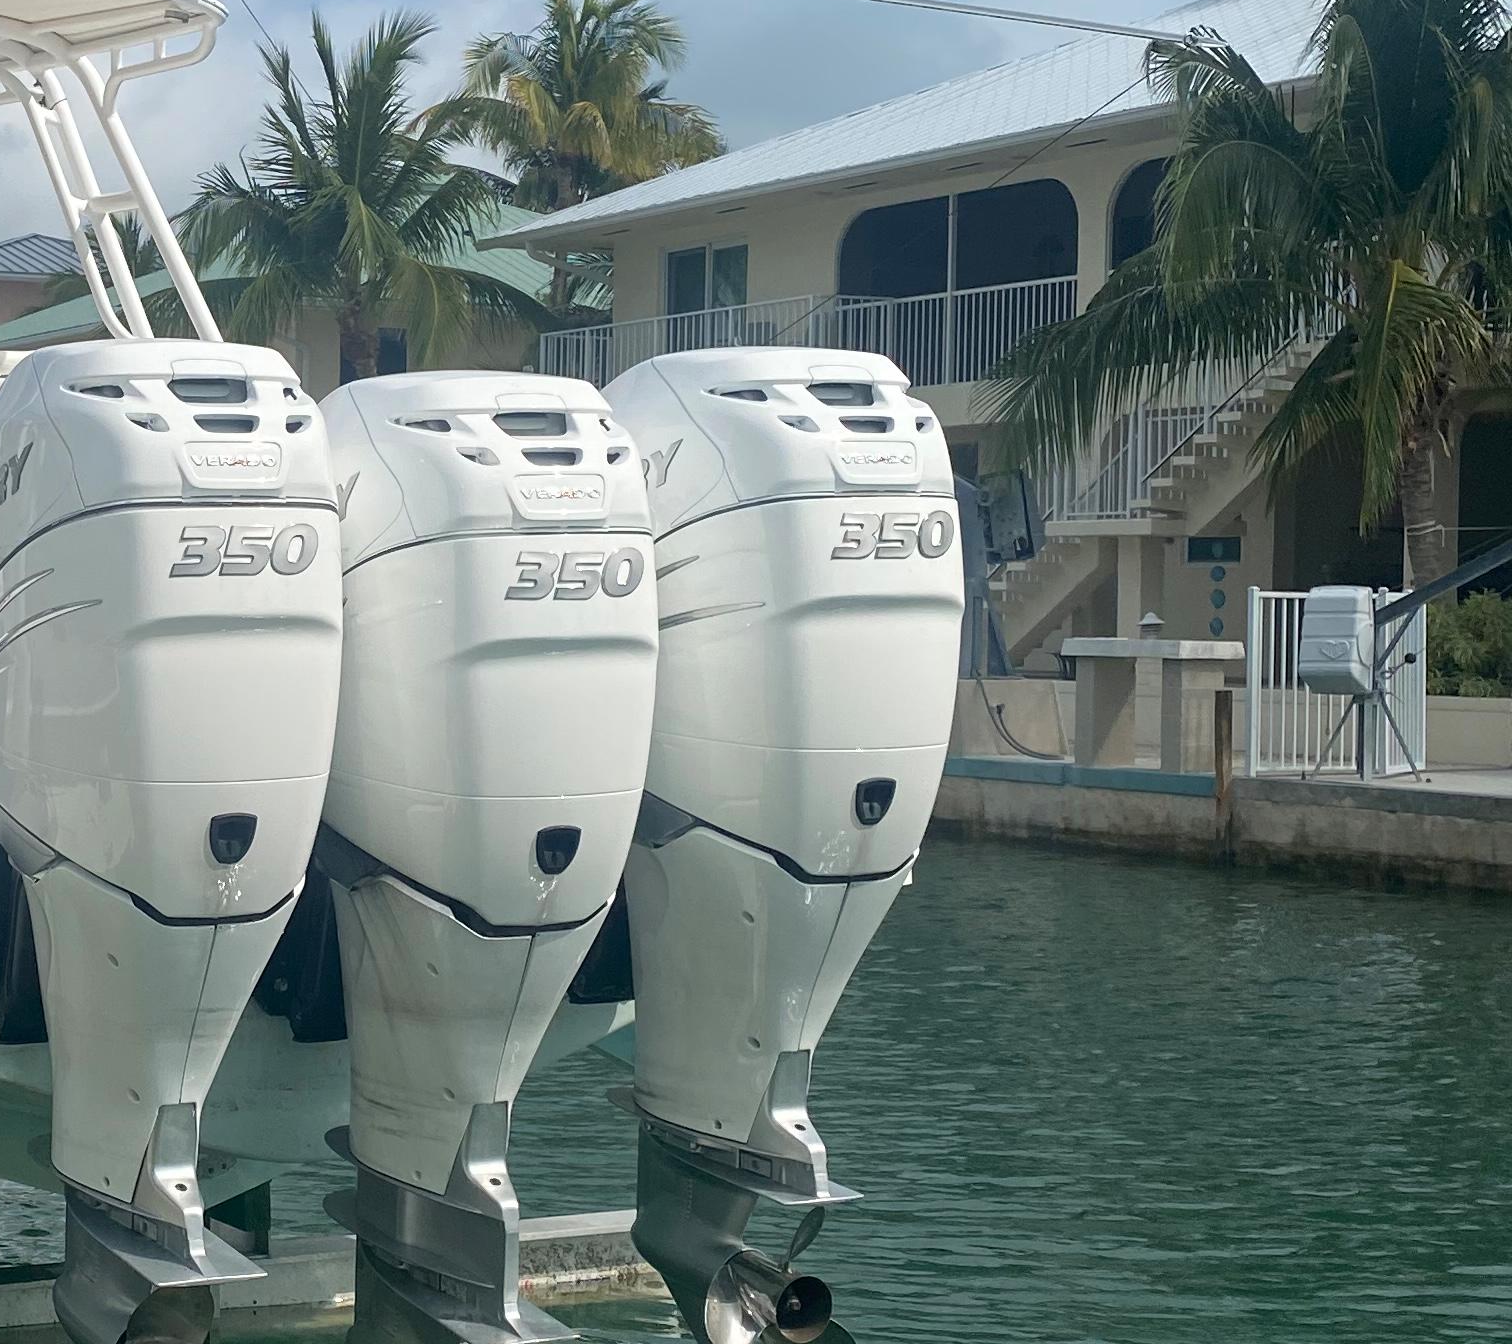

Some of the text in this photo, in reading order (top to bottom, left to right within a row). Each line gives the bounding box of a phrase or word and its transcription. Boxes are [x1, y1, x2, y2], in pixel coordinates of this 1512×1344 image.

[190, 455, 277, 468] VERADO
[520, 488, 601, 500] VERADO
[168, 523, 319, 579] 350
[830, 510, 955, 561] 350
[504, 546, 645, 601] 350
